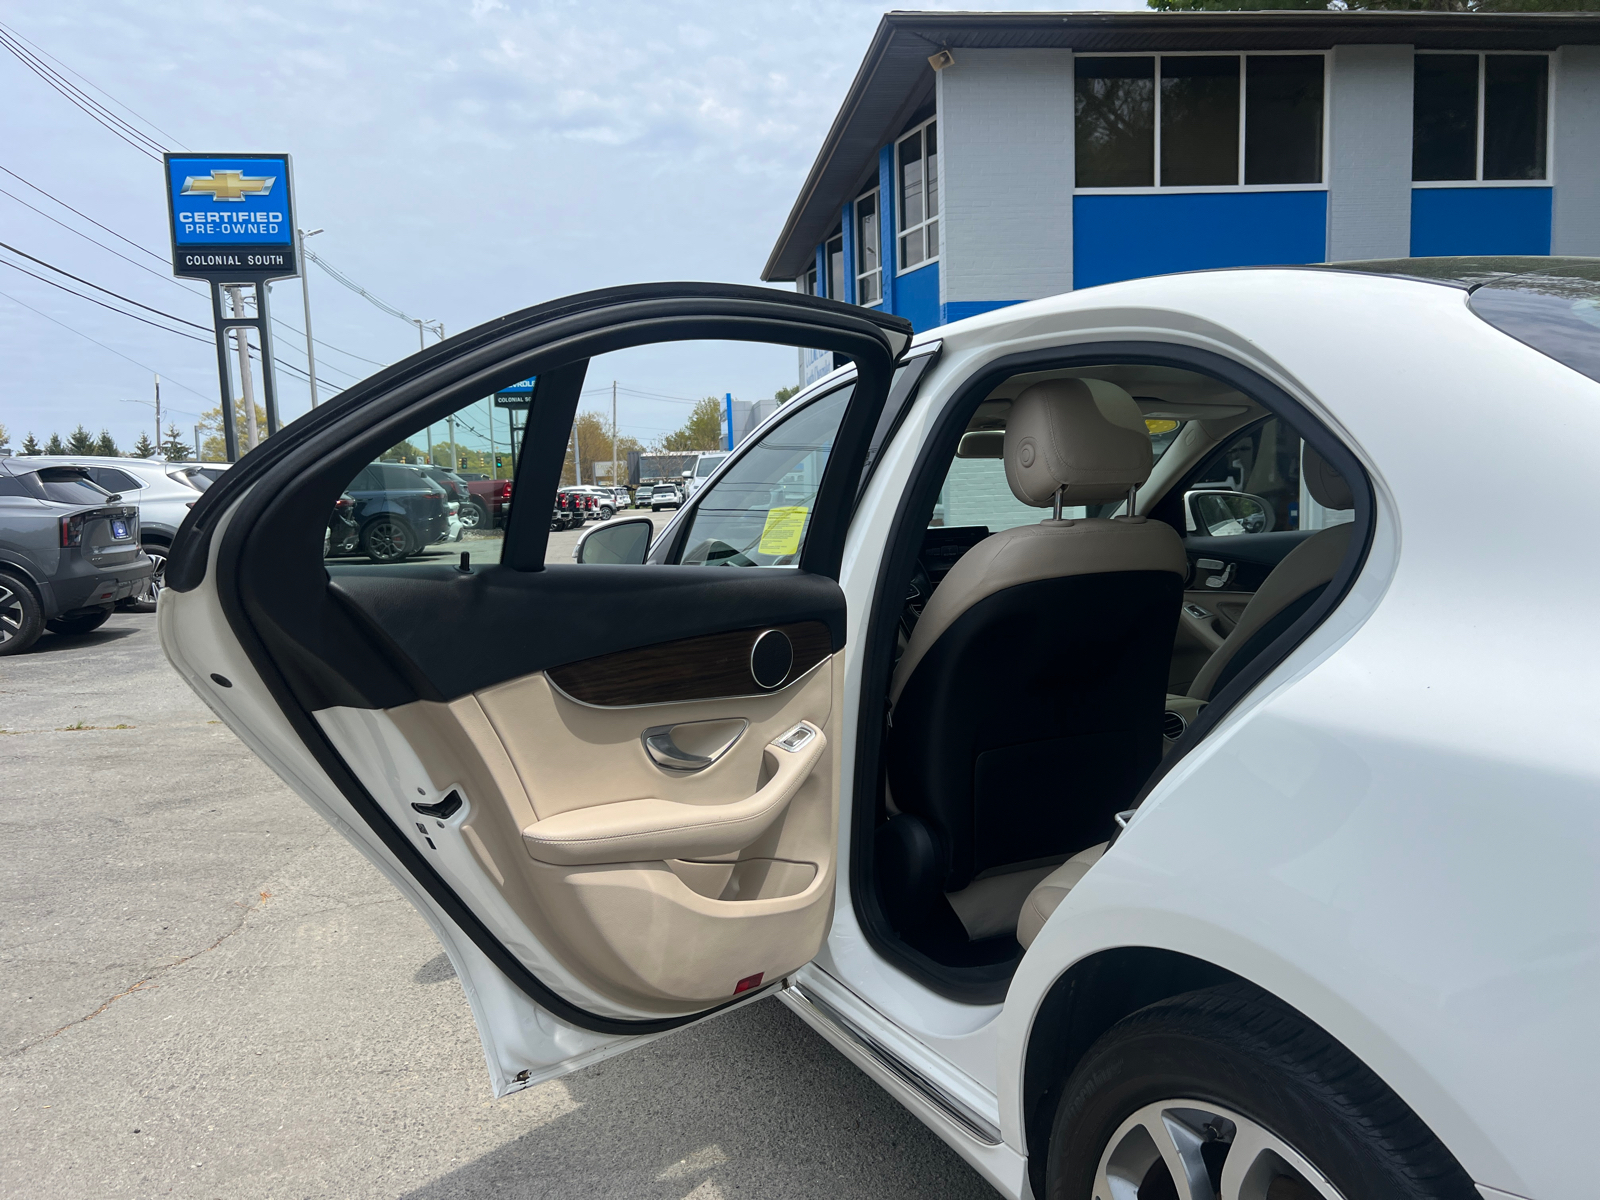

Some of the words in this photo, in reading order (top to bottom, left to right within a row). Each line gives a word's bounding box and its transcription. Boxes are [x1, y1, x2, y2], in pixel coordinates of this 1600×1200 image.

[179, 212, 282, 222] CERTIFIED
[186, 224, 278, 234] PRE-OWNED
[186, 255, 242, 265] COLONIAL
[247, 255, 284, 265] SOUTH
